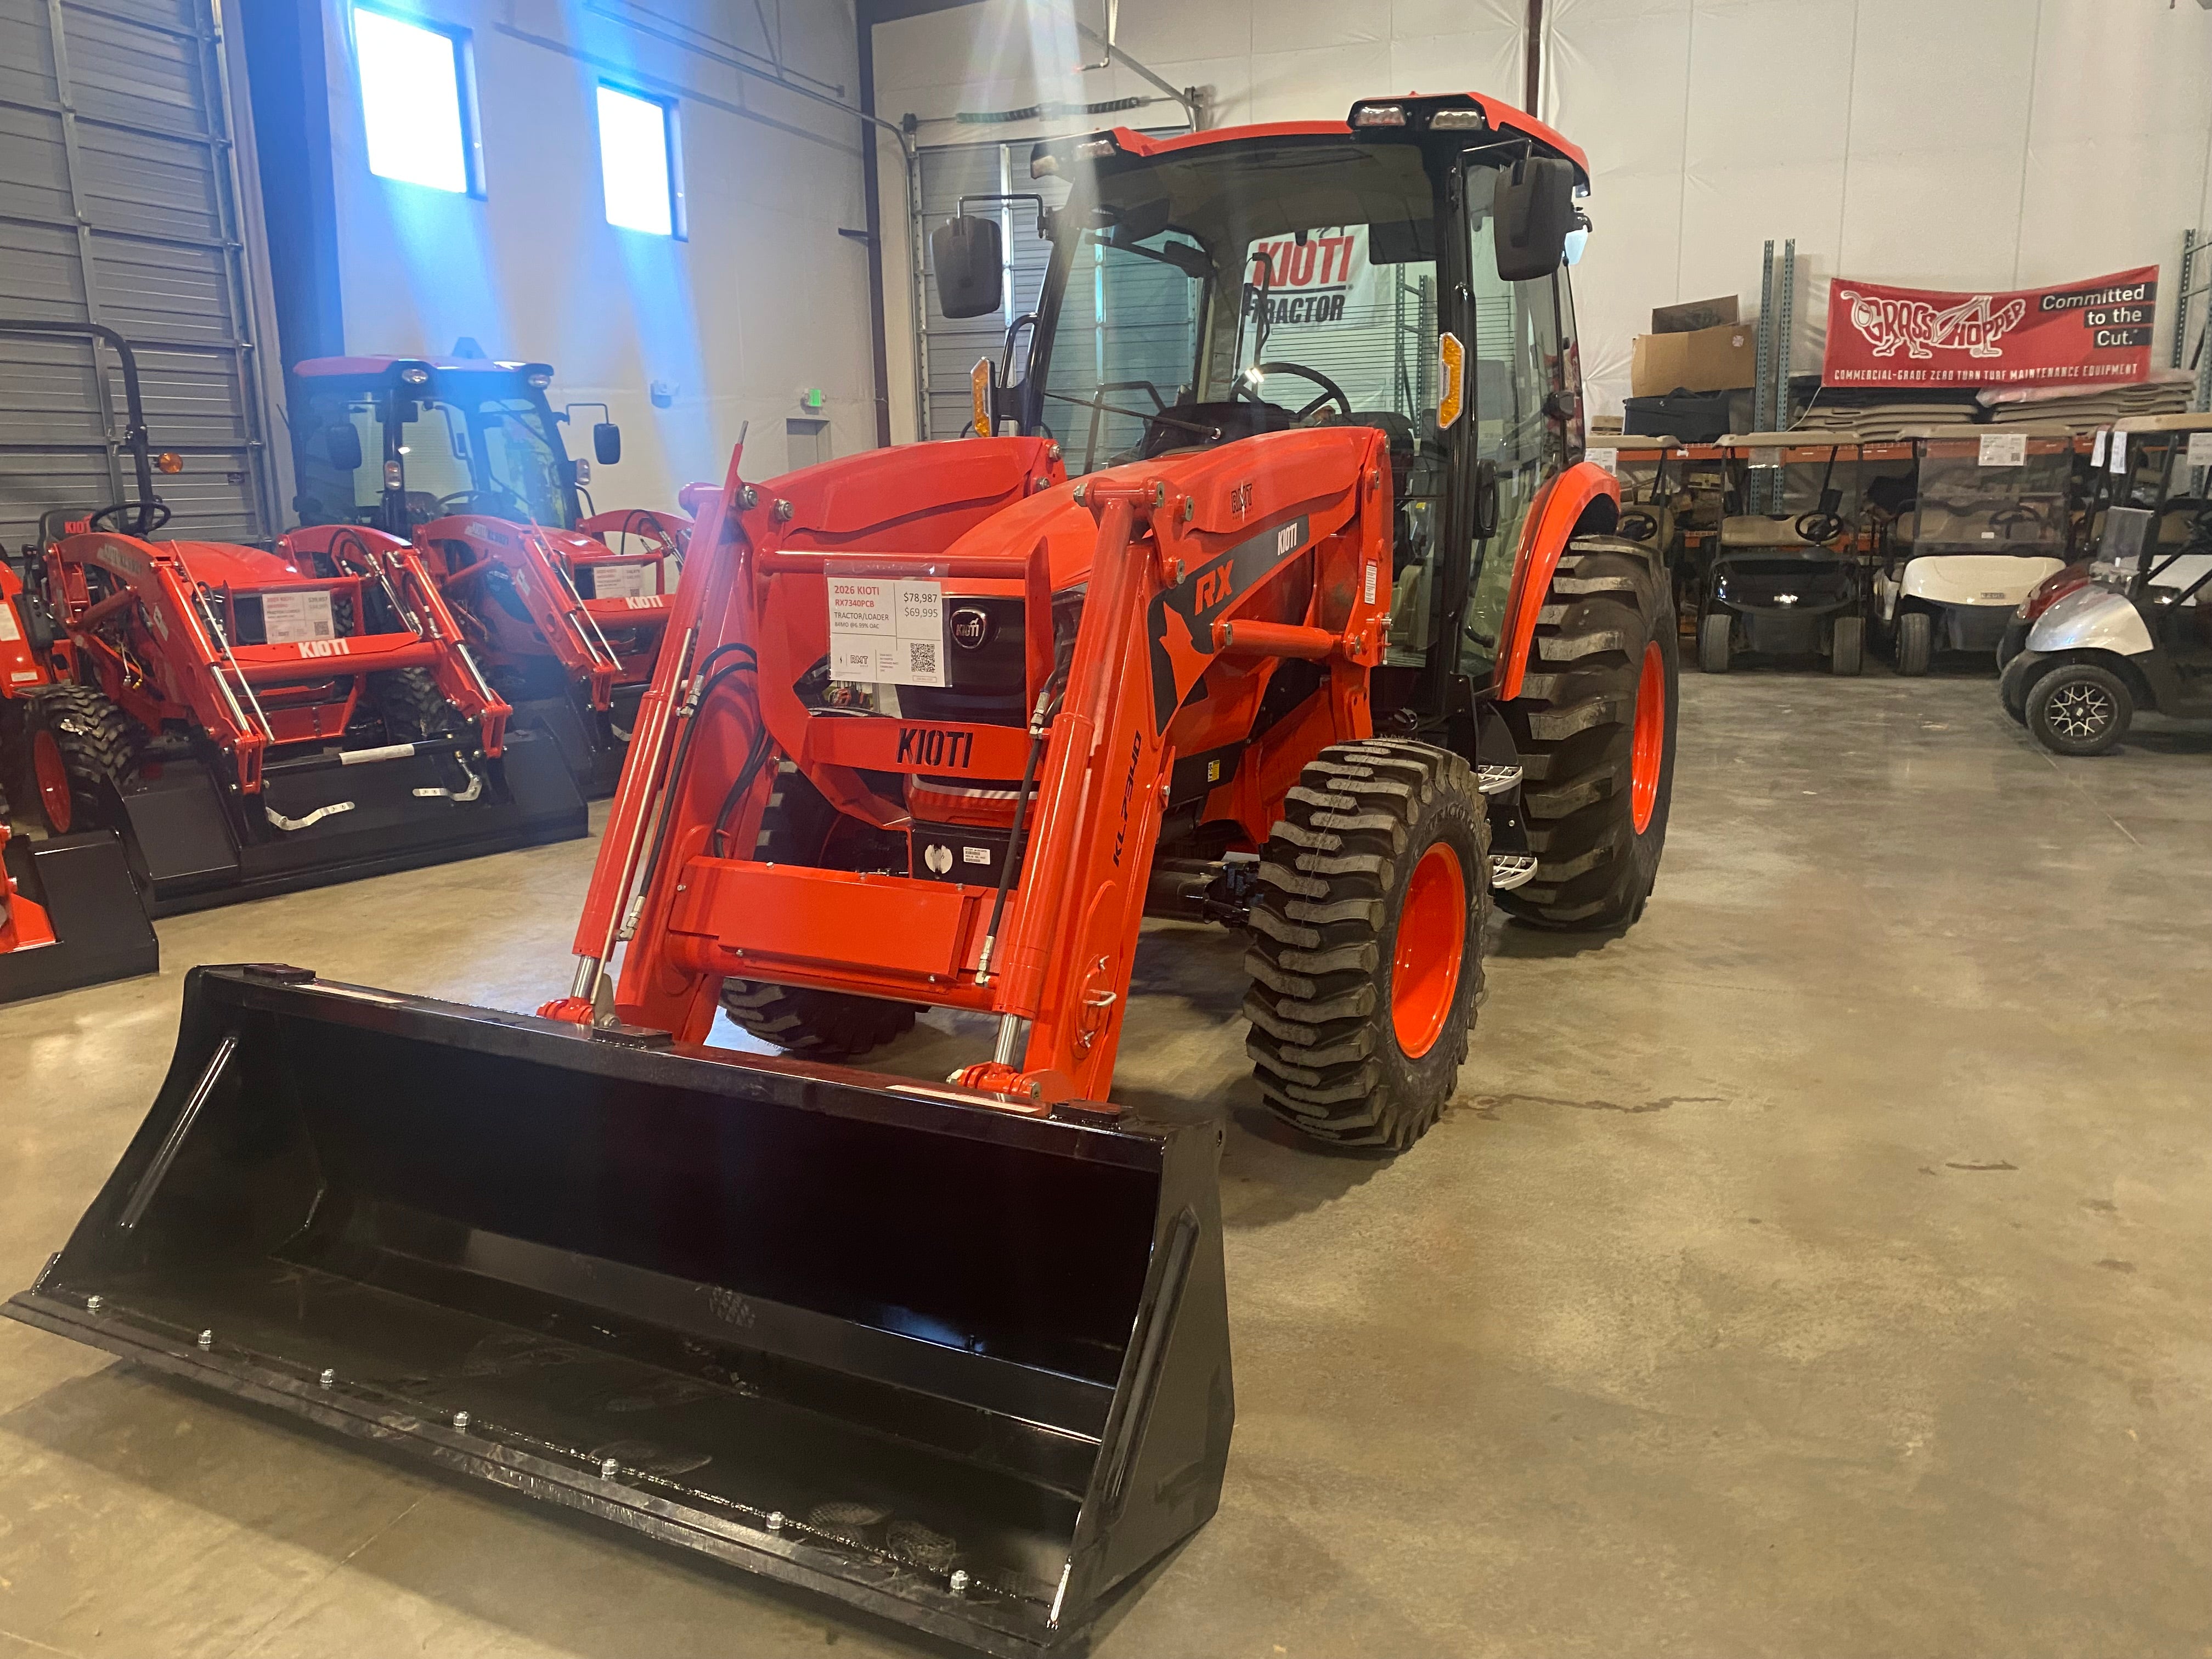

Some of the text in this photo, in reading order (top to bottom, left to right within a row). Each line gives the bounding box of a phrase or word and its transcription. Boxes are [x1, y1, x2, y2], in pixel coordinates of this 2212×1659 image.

[1252, 236, 1355, 286] KIOTI
[2042, 284, 2146, 310] Committed
[2087, 308, 2142, 325] to the
[2097, 330, 2133, 346] Cut.
[1835, 363, 2137, 381] COMMERCIAL-GRADE ZERO TURN TURF MAINTENANCE EQUIPMENT
[65, 521, 92, 534] KIOT
[1278, 523, 1297, 556] KIOTI
[834, 585, 879, 595] 2026 KIOTI
[1194, 559, 1234, 616] RX
[625, 595, 663, 610] KIOTI
[835, 599, 874, 607] RX7340PCB
[904, 591, 938, 603] $78,987
[834, 612, 889, 620] TRACTOR/LOADER
[904, 606, 938, 618] $69,995
[956, 624, 979, 637] KIOTI
[298, 639, 351, 659] KIOTI
[850, 654, 868, 664] RMT
[897, 728, 974, 768] KIOTI
[1113, 729, 1142, 867] KL7340
